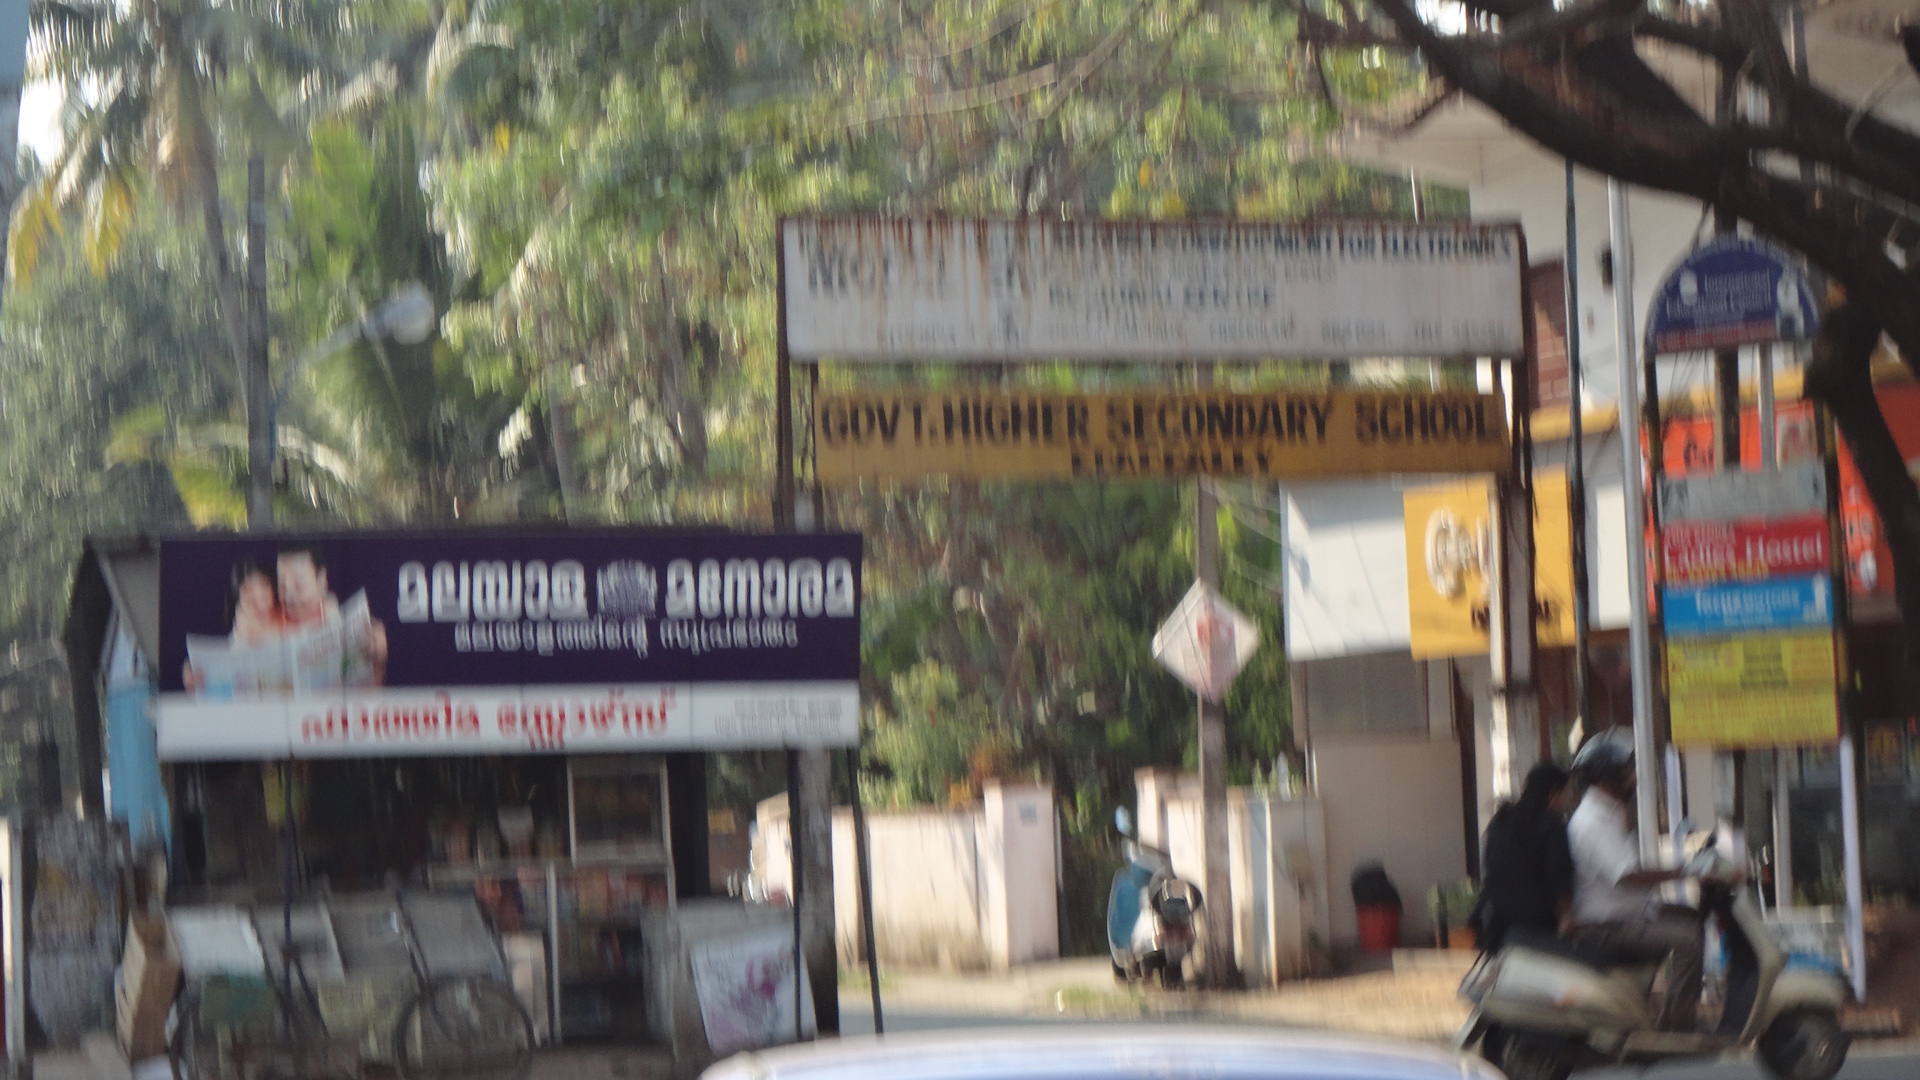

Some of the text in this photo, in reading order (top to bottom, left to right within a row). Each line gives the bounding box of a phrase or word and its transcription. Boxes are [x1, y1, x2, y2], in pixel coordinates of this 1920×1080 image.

[1106, 401, 1335, 446] SECONDARY
[1354, 400, 1502, 444] SCHOOL
[396, 557, 855, 624] മലയാള മനോരമ
